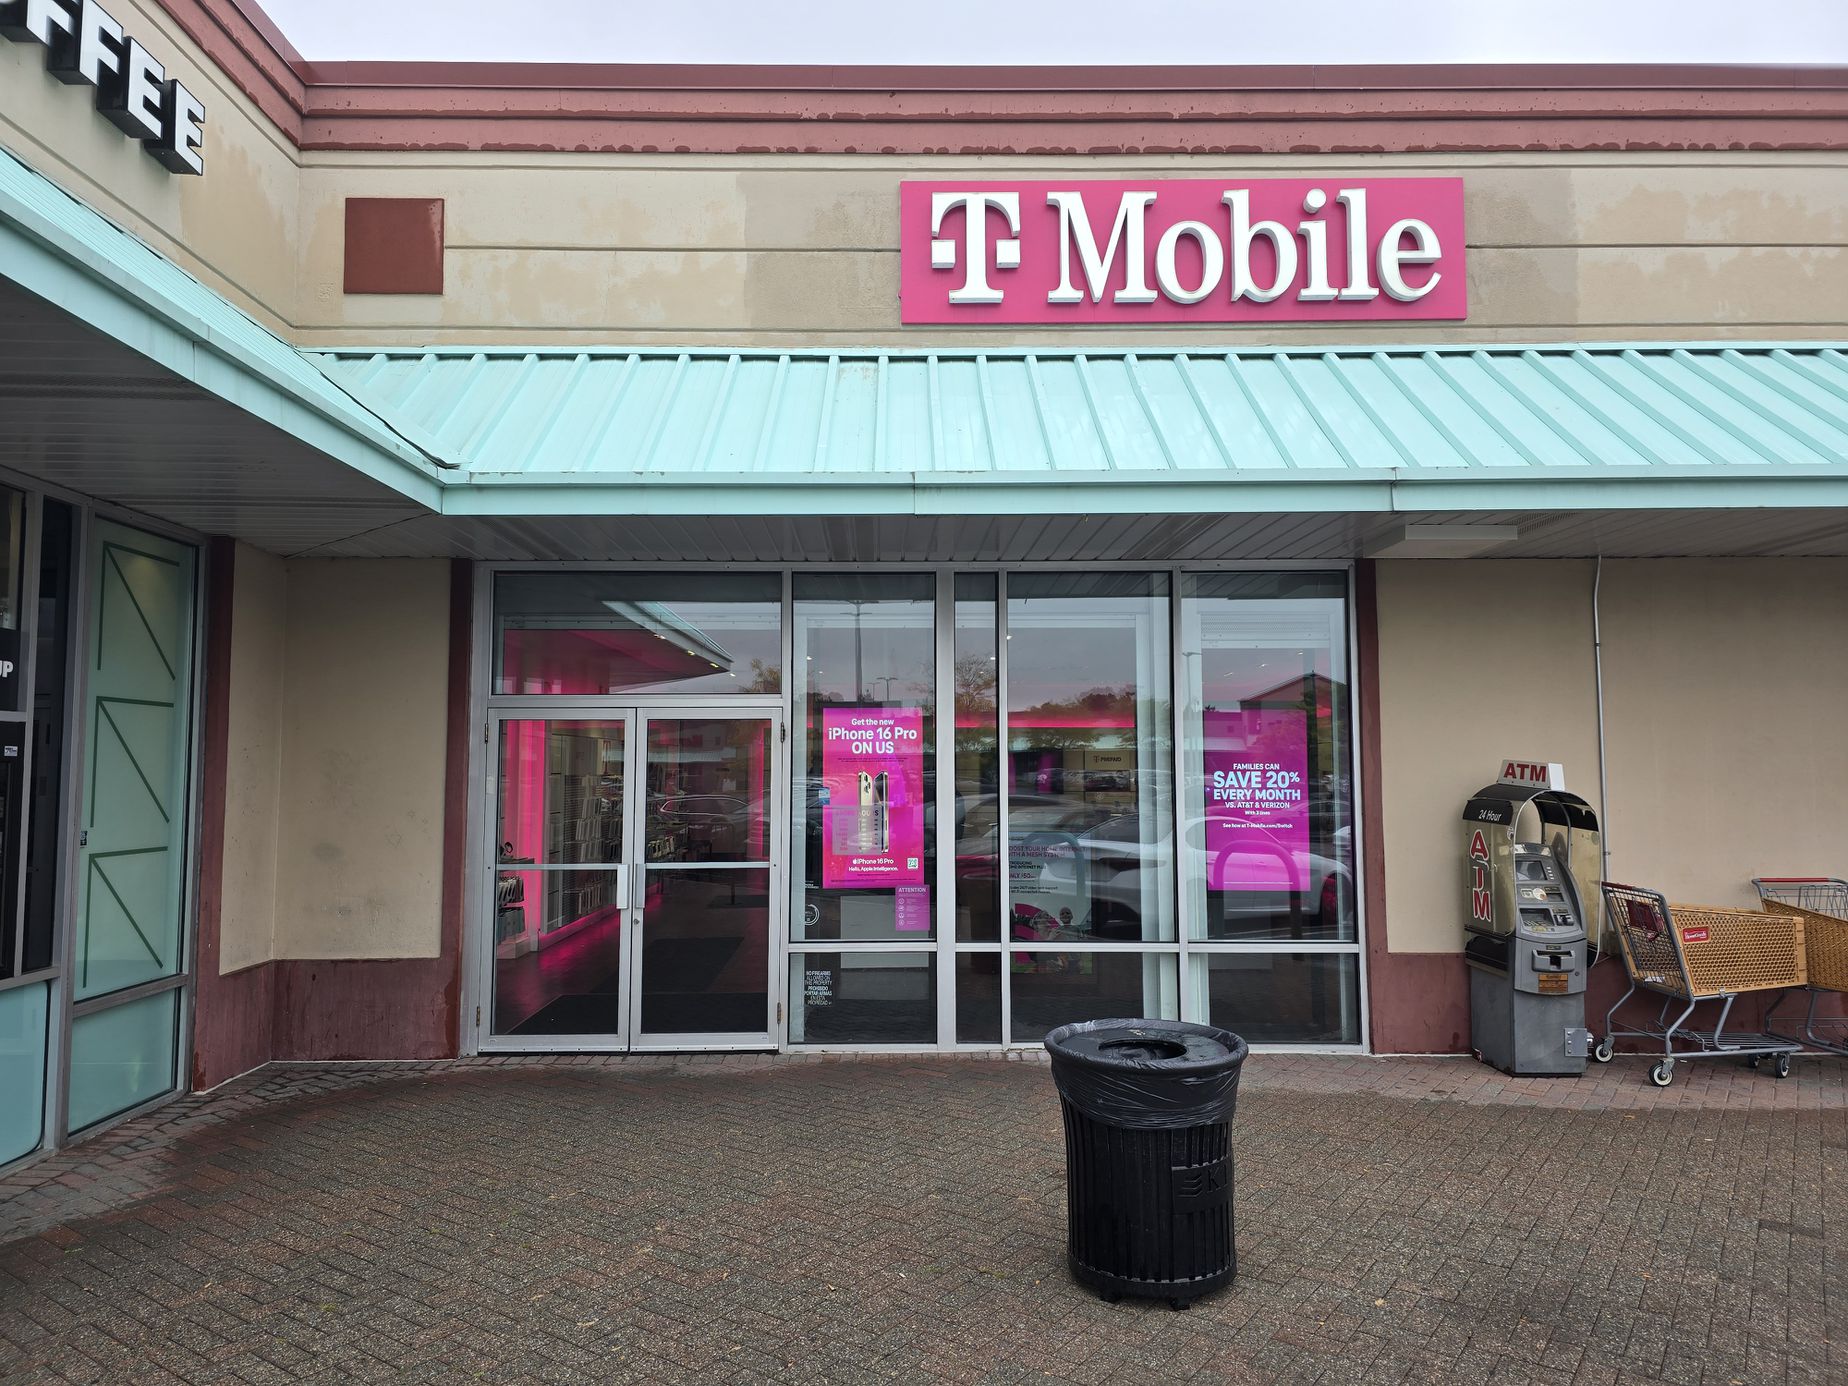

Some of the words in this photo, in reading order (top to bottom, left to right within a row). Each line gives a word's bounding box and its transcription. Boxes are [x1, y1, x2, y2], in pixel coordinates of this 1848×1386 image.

[1046, 187, 1442, 305] Mobile
[851, 718, 865, 726] Get
[866, 718, 878, 726] the
[828, 727, 874, 740] iPhone
[876, 727, 892, 740] 16
[894, 727, 918, 740] Pro
[851, 741, 872, 754] ON
[875, 741, 895, 754] US
[1503, 762, 1547, 783] ATM
[1213, 771, 1262, 788] SAVE
[1265, 771, 1300, 788] 20%
[1213, 789, 1253, 800] EVERY
[1255, 789, 1301, 801] MONTH
[1478, 809, 1487, 820] 24
[1486, 810, 1503, 821] Hour
